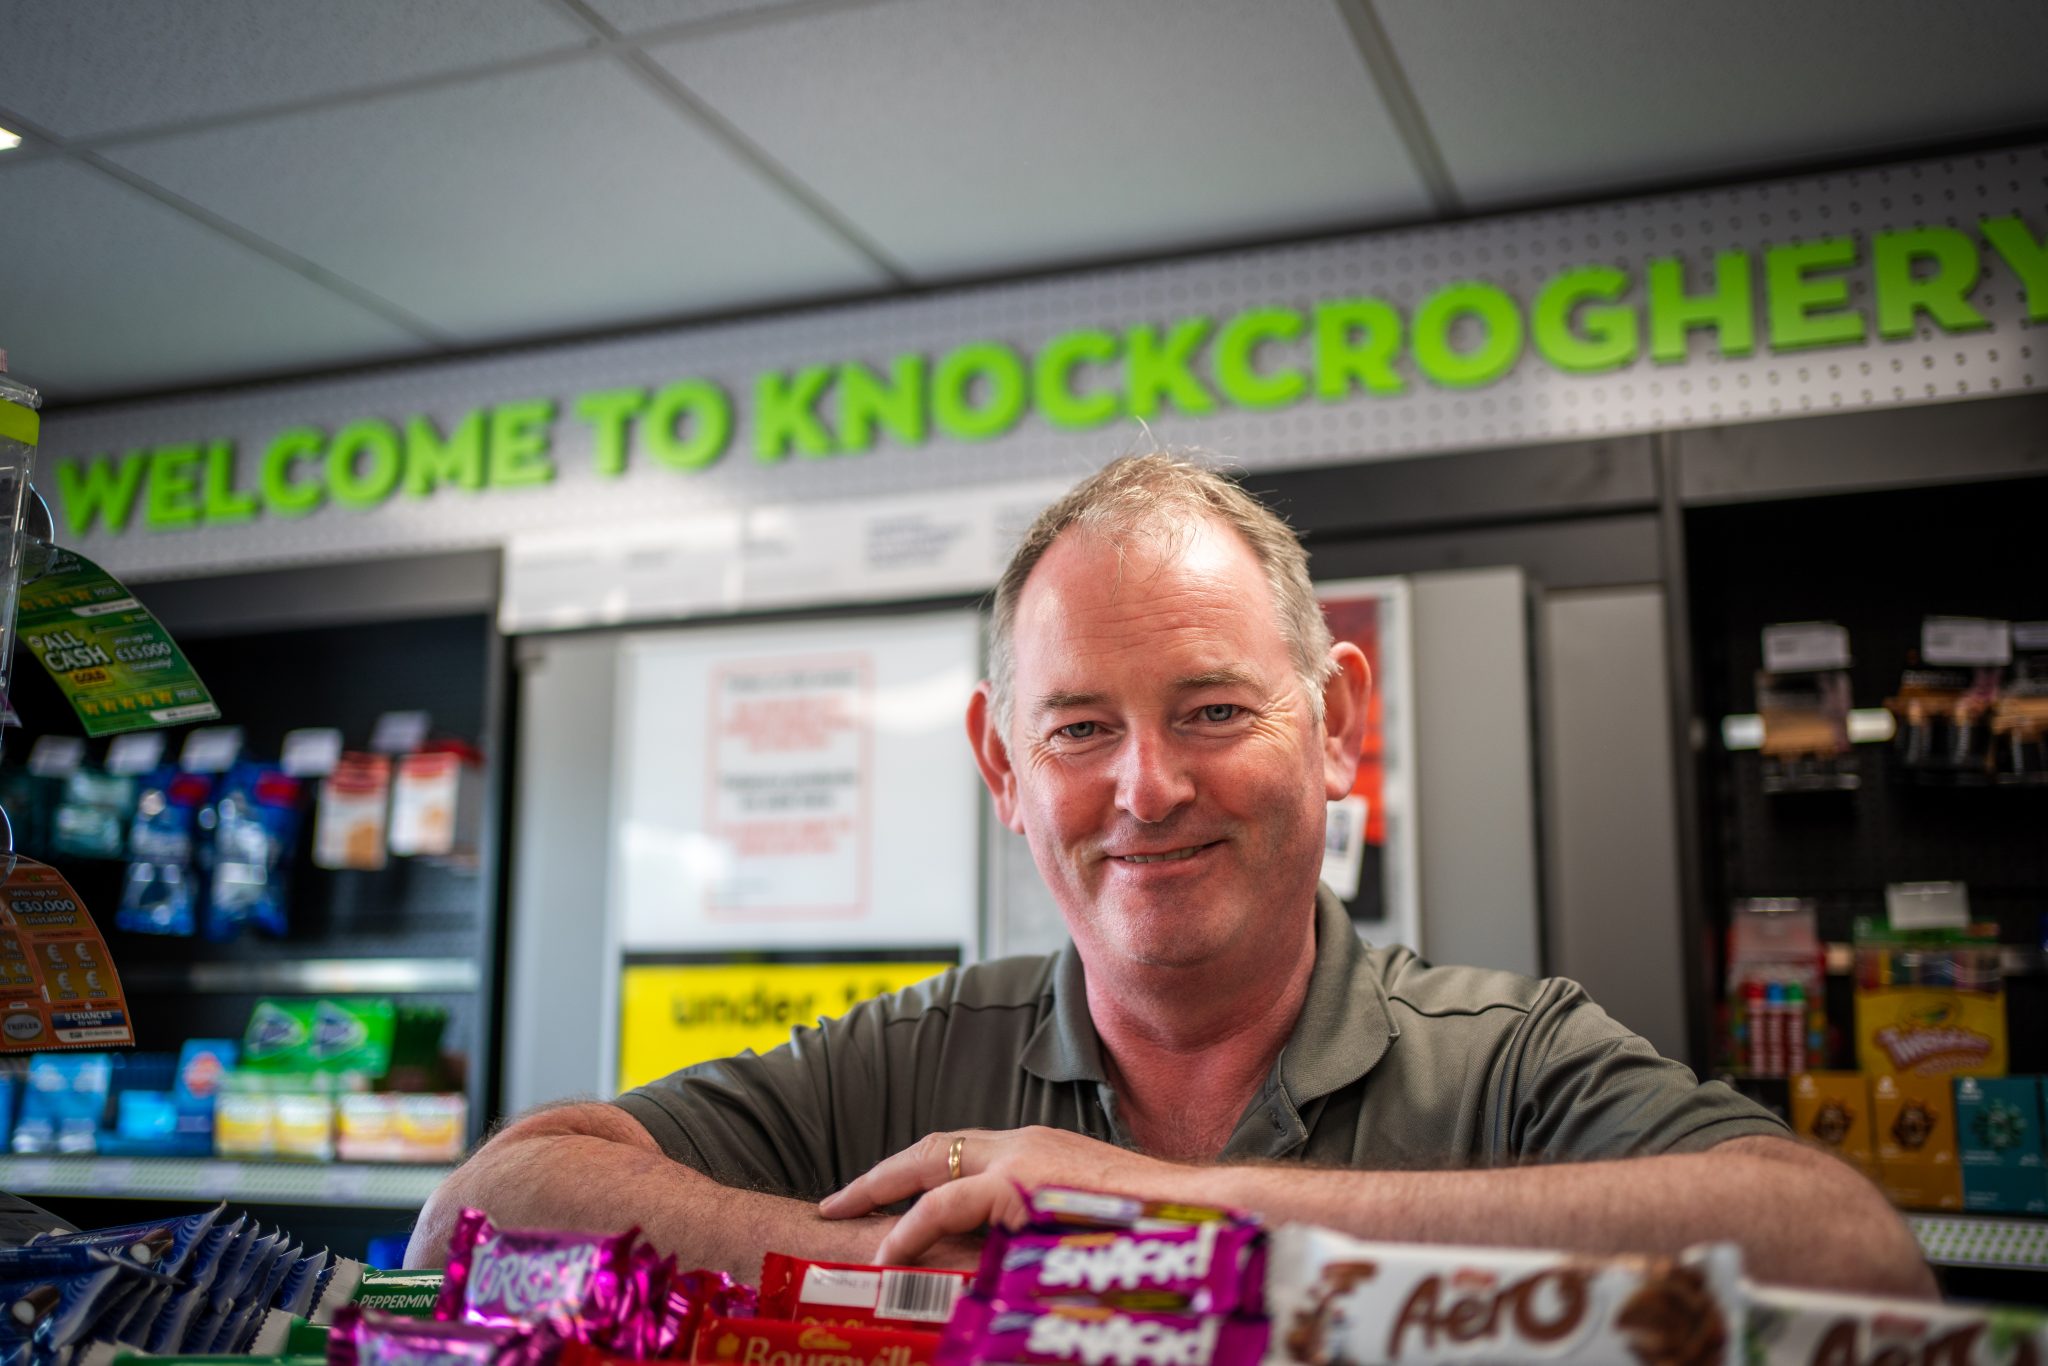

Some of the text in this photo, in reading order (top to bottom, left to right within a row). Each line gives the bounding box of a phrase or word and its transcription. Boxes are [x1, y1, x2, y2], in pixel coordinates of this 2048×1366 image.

[56, 217, 2048, 535] WELCOME TO KNOCKCROGHERY
[44, 630, 85, 651] ALL
[44, 643, 111, 672] CASH
[11, 899, 76, 913] €30,000
[72, 1011, 112, 1020] CHANCES
[671, 982, 812, 1023] under
[743, 1336, 930, 1366] Bournvill
